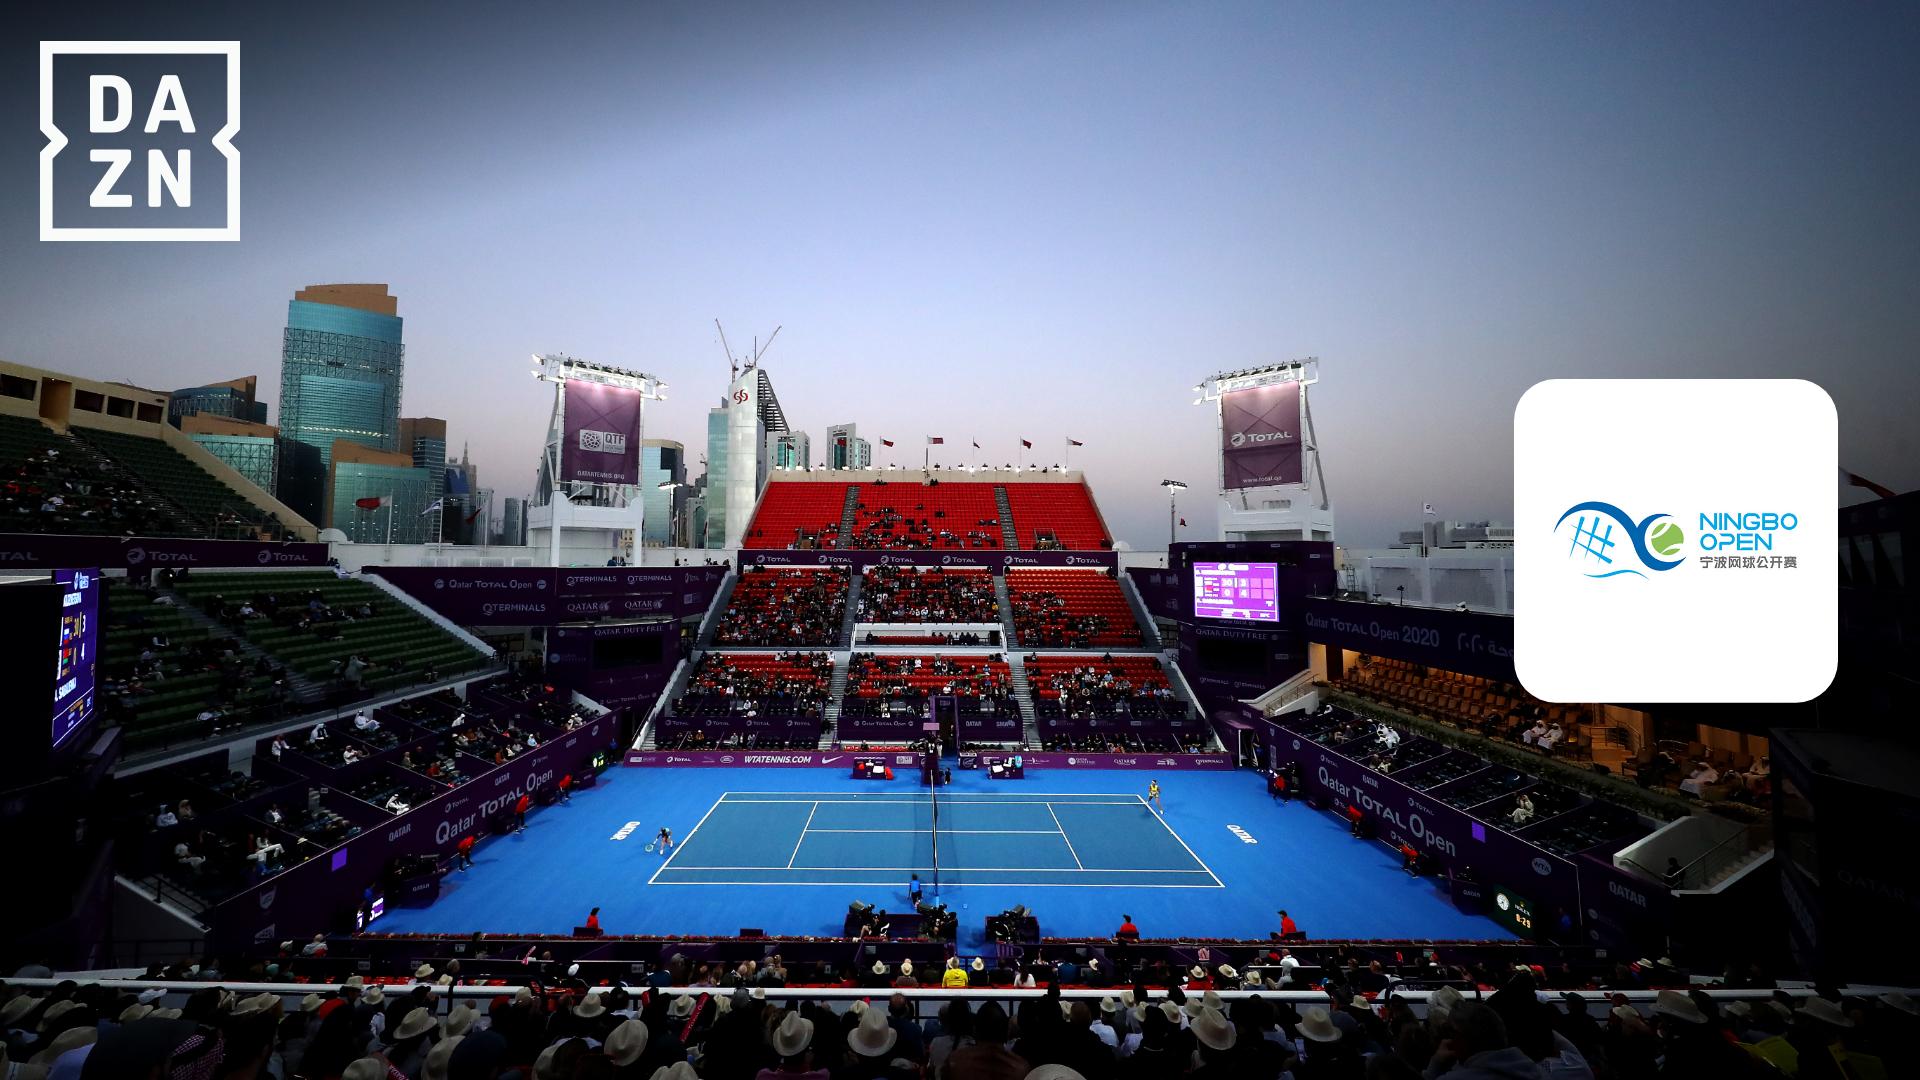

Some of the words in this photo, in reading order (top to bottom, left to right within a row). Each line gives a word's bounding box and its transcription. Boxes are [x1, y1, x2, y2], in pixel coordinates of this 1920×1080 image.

[605, 433, 625, 444] QTF
[1248, 431, 1292, 442] TOTAL
[1243, 475, 1282, 484] www.total.qa
[149, 551, 198, 561] TOTAL
[273, 552, 309, 561] TOTAL
[952, 556, 976, 564] TOTAL
[1013, 556, 1038, 564] TOTAL
[448, 579, 473, 589] Qatar
[474, 580, 508, 589] TOTAL
[508, 579, 533, 590] Open
[566, 575, 617, 587] QTERMINALS
[627, 575, 672, 585] QTERMINALS
[482, 603, 546, 616] QTERMINALS
[567, 602, 598, 612] QATAR
[624, 600, 653, 609] QATAR
[594, 628, 622, 636] QATAR
[1223, 629, 1246, 639] DUTY
[1247, 631, 1269, 640] FREE
[1305, 611, 1329, 629] Qatar
[1330, 617, 1368, 635] TOTAL
[1369, 621, 1400, 641] Open
[1401, 624, 1441, 648] 2020
[744, 755, 812, 764] WTATENNIS.COM
[435, 813, 477, 846] Qatar
[478, 786, 525, 819] TOTAL
[526, 769, 553, 792] Open
[1318, 766, 1351, 798] Qatar
[1351, 785, 1407, 831] TOTAL
[1408, 813, 1457, 858] Open
[388, 823, 412, 843] QATAR
[1608, 880, 1648, 908] QATAR
[1514, 904, 1531, 917] ROLEX
